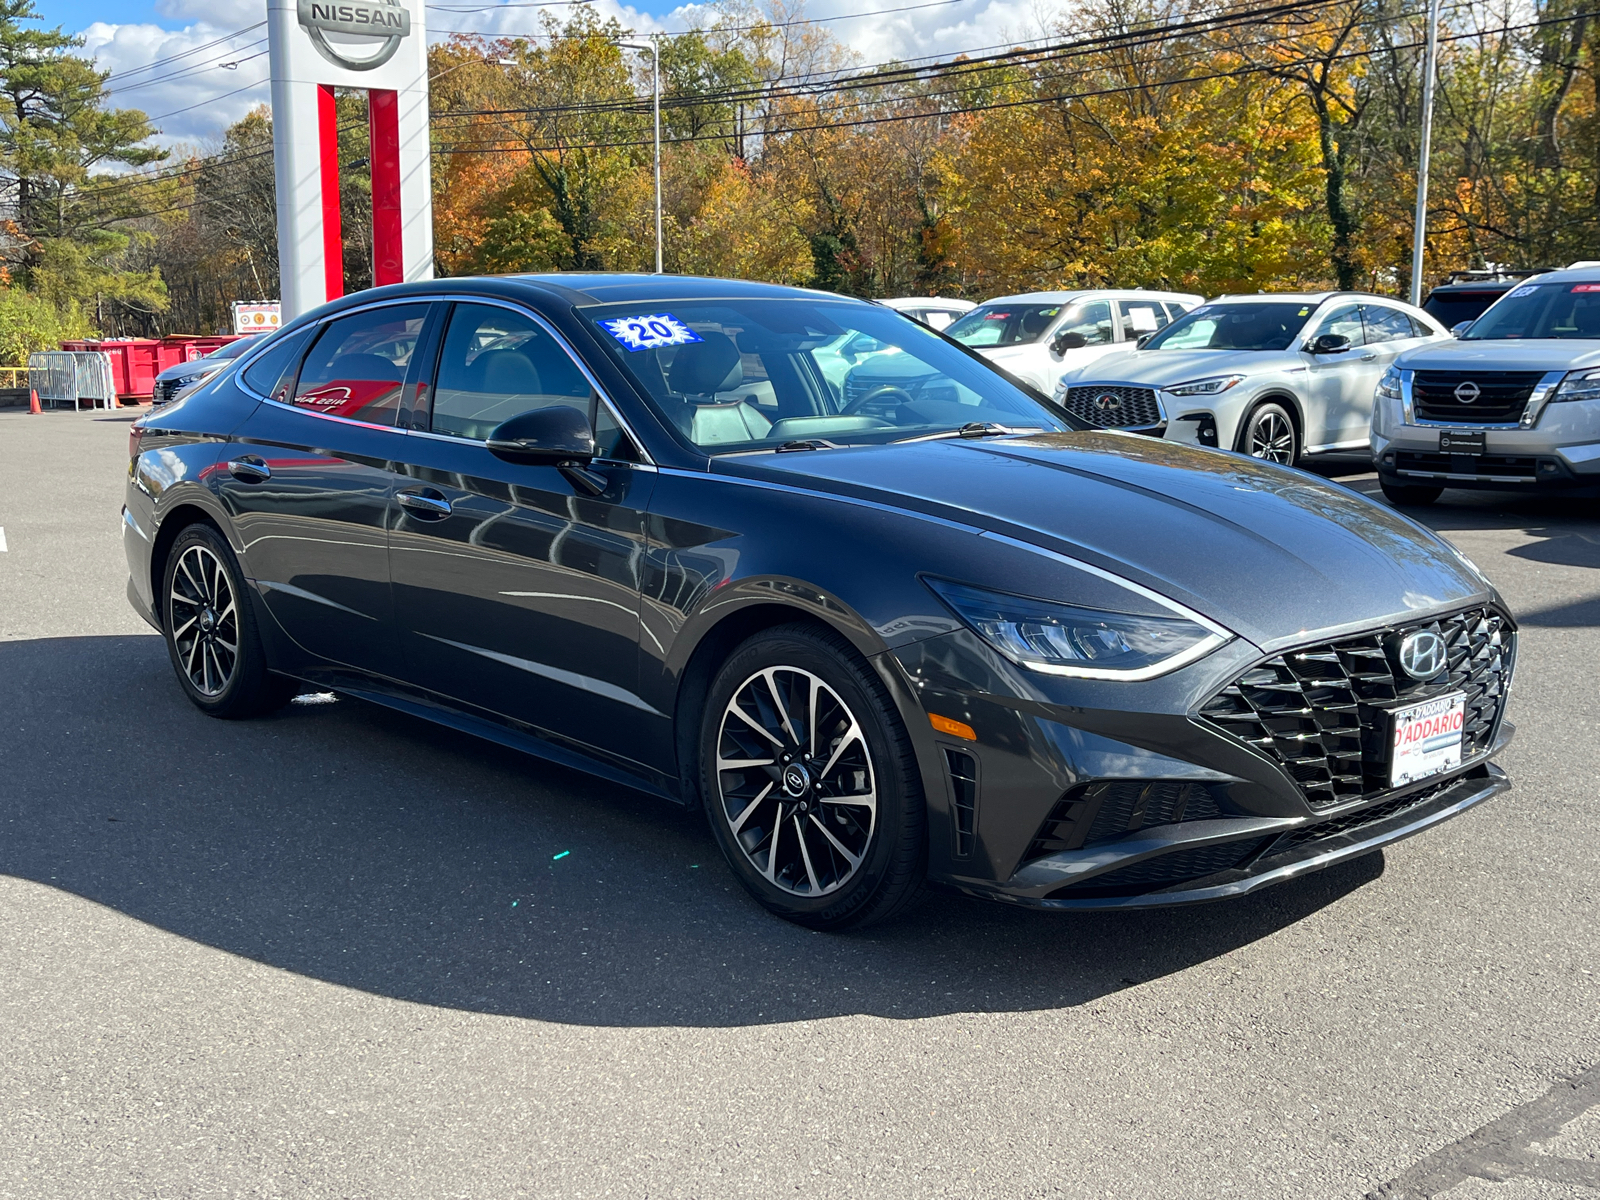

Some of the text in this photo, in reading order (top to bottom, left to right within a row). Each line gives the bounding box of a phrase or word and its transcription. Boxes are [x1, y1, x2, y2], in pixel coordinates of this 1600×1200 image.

[312, 4, 402, 29] NISSAN
[628, 321, 673, 341] 20
[1415, 699, 1452, 719] D'ADDARIO
[1394, 711, 1463, 748] D'ADDARIO
[822, 885, 876, 926] KUMHO
